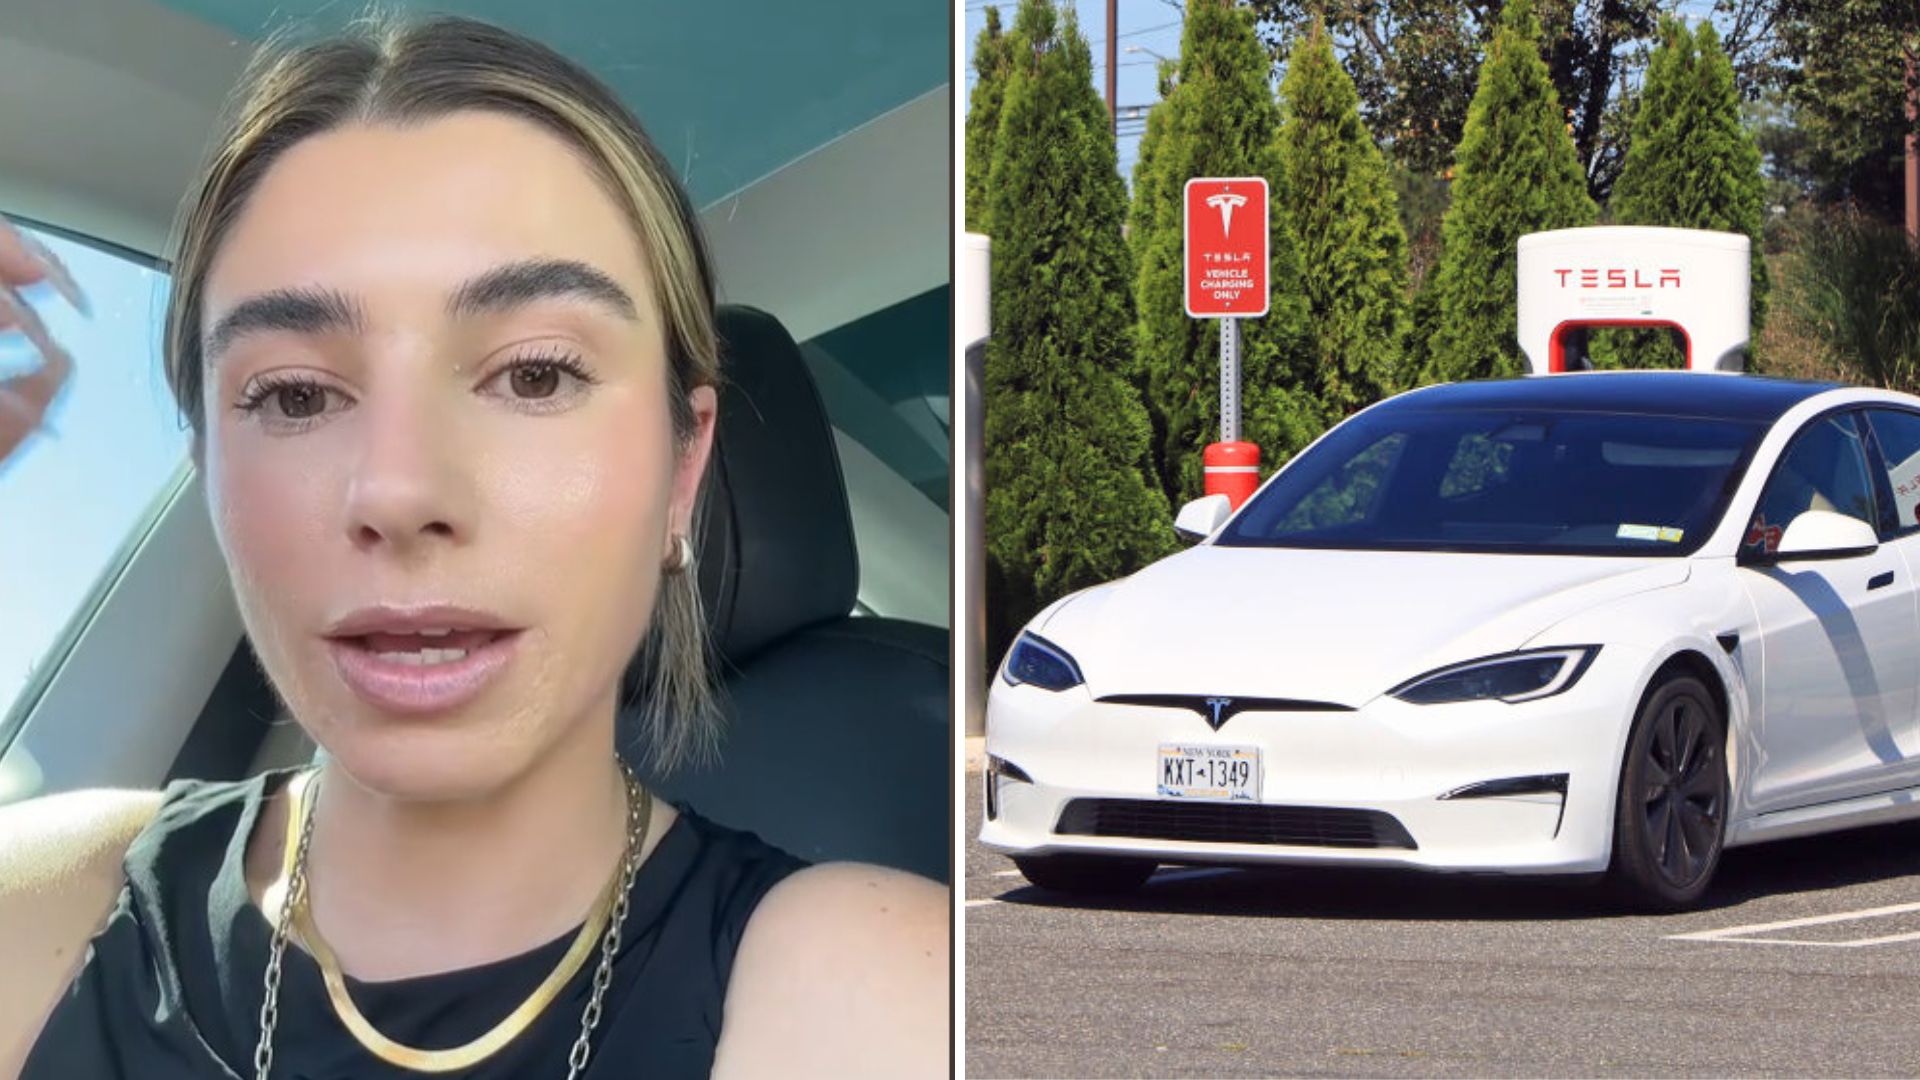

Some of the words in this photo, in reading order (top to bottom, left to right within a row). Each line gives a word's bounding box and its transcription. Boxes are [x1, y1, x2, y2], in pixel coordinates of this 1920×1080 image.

[1203, 252, 1252, 262] TESLA
[1206, 269, 1248, 278] VEHICLE
[1553, 269, 1680, 288] TESLA
[1200, 279, 1254, 289] CHARGING
[1213, 290, 1240, 299] ONLY
[1183, 747, 1204, 757] NEW
[1206, 749, 1231, 759] YORK
